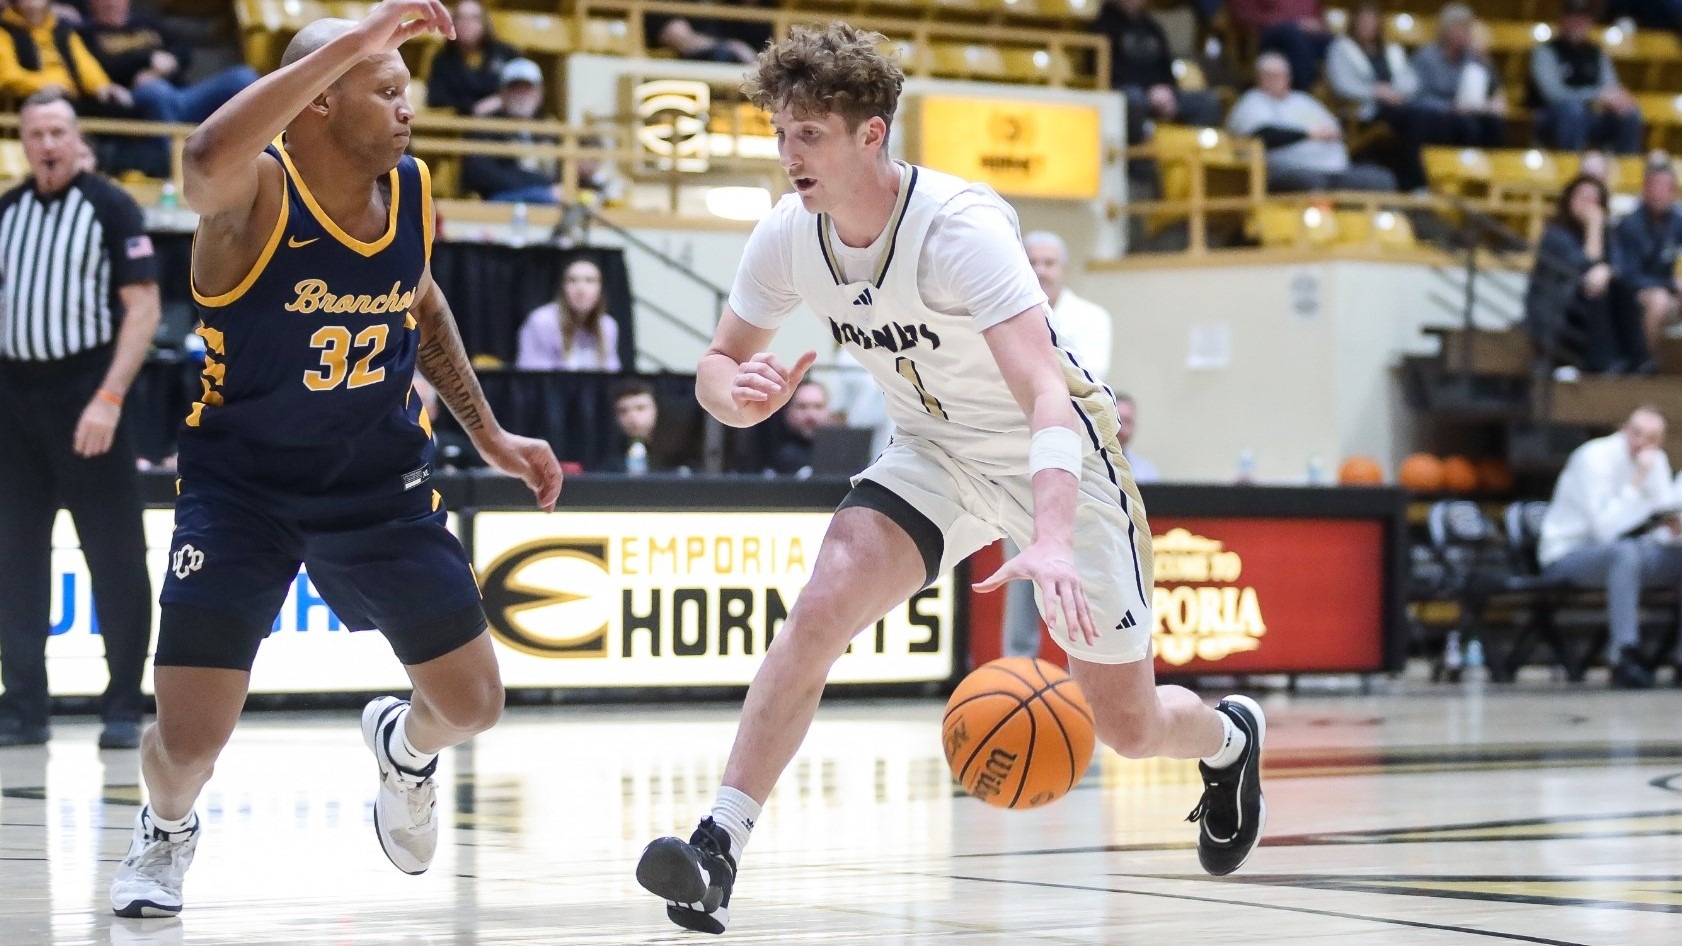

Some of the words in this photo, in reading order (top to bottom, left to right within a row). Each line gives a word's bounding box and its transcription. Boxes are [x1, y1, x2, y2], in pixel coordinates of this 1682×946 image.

[303, 324, 389, 391] 32
[895, 356, 949, 420] 1
[621, 536, 806, 575] EMPORIA
[622, 588, 939, 658] HORNS
[1152, 586, 1266, 636] PORIA
